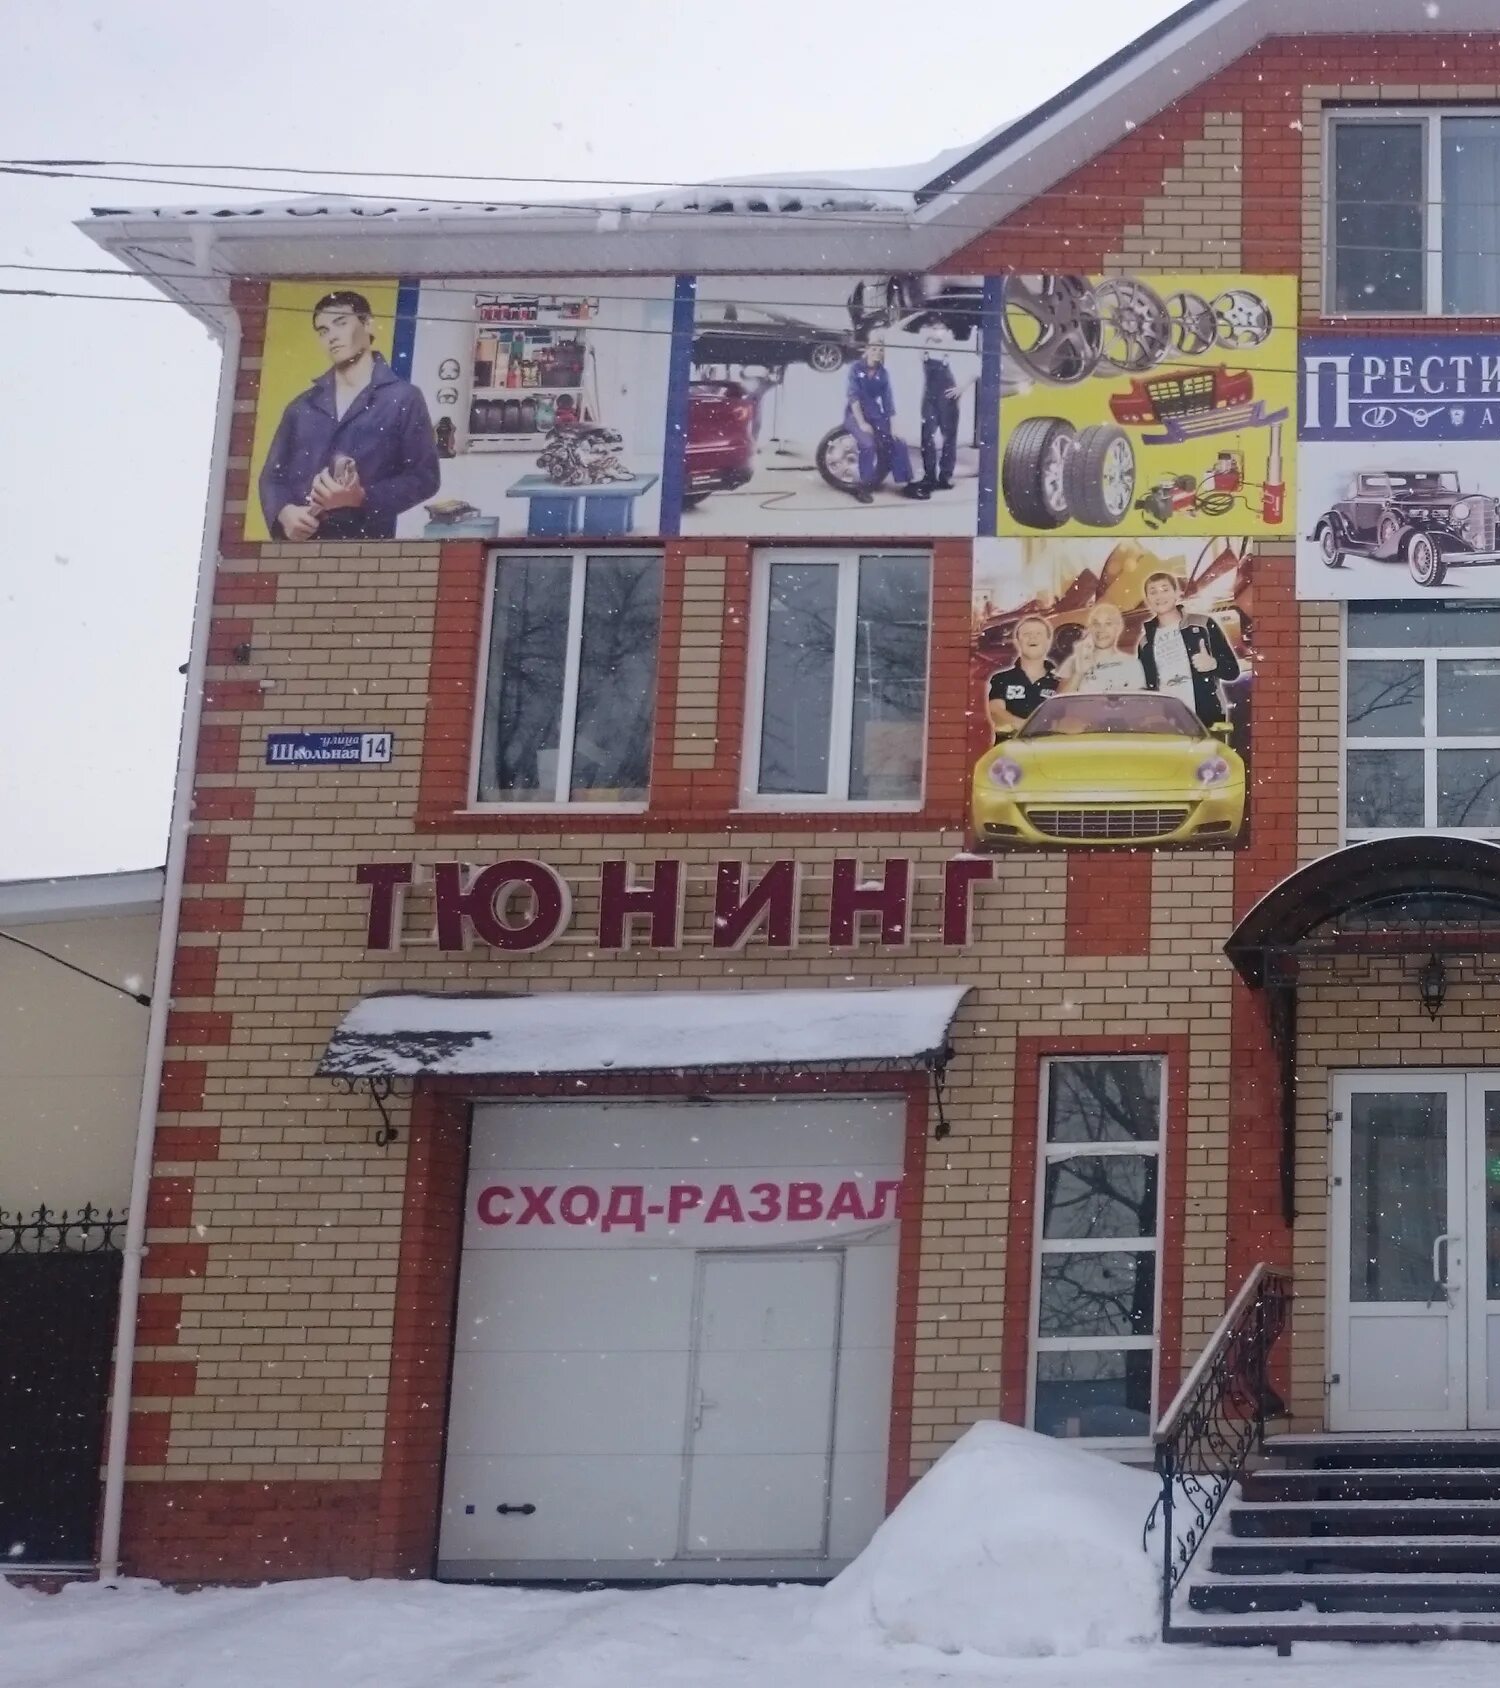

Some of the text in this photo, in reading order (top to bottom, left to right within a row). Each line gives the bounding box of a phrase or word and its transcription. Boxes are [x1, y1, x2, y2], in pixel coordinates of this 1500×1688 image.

[1006, 684, 1026, 700] 52
[320, 736, 360, 747] улица
[366, 737, 386, 759] 14
[271, 743, 360, 761] Школьная
[356, 857, 994, 953] ТЮНИНГ
[476, 1180, 902, 1233] СХОД-РАЗВАЛ
